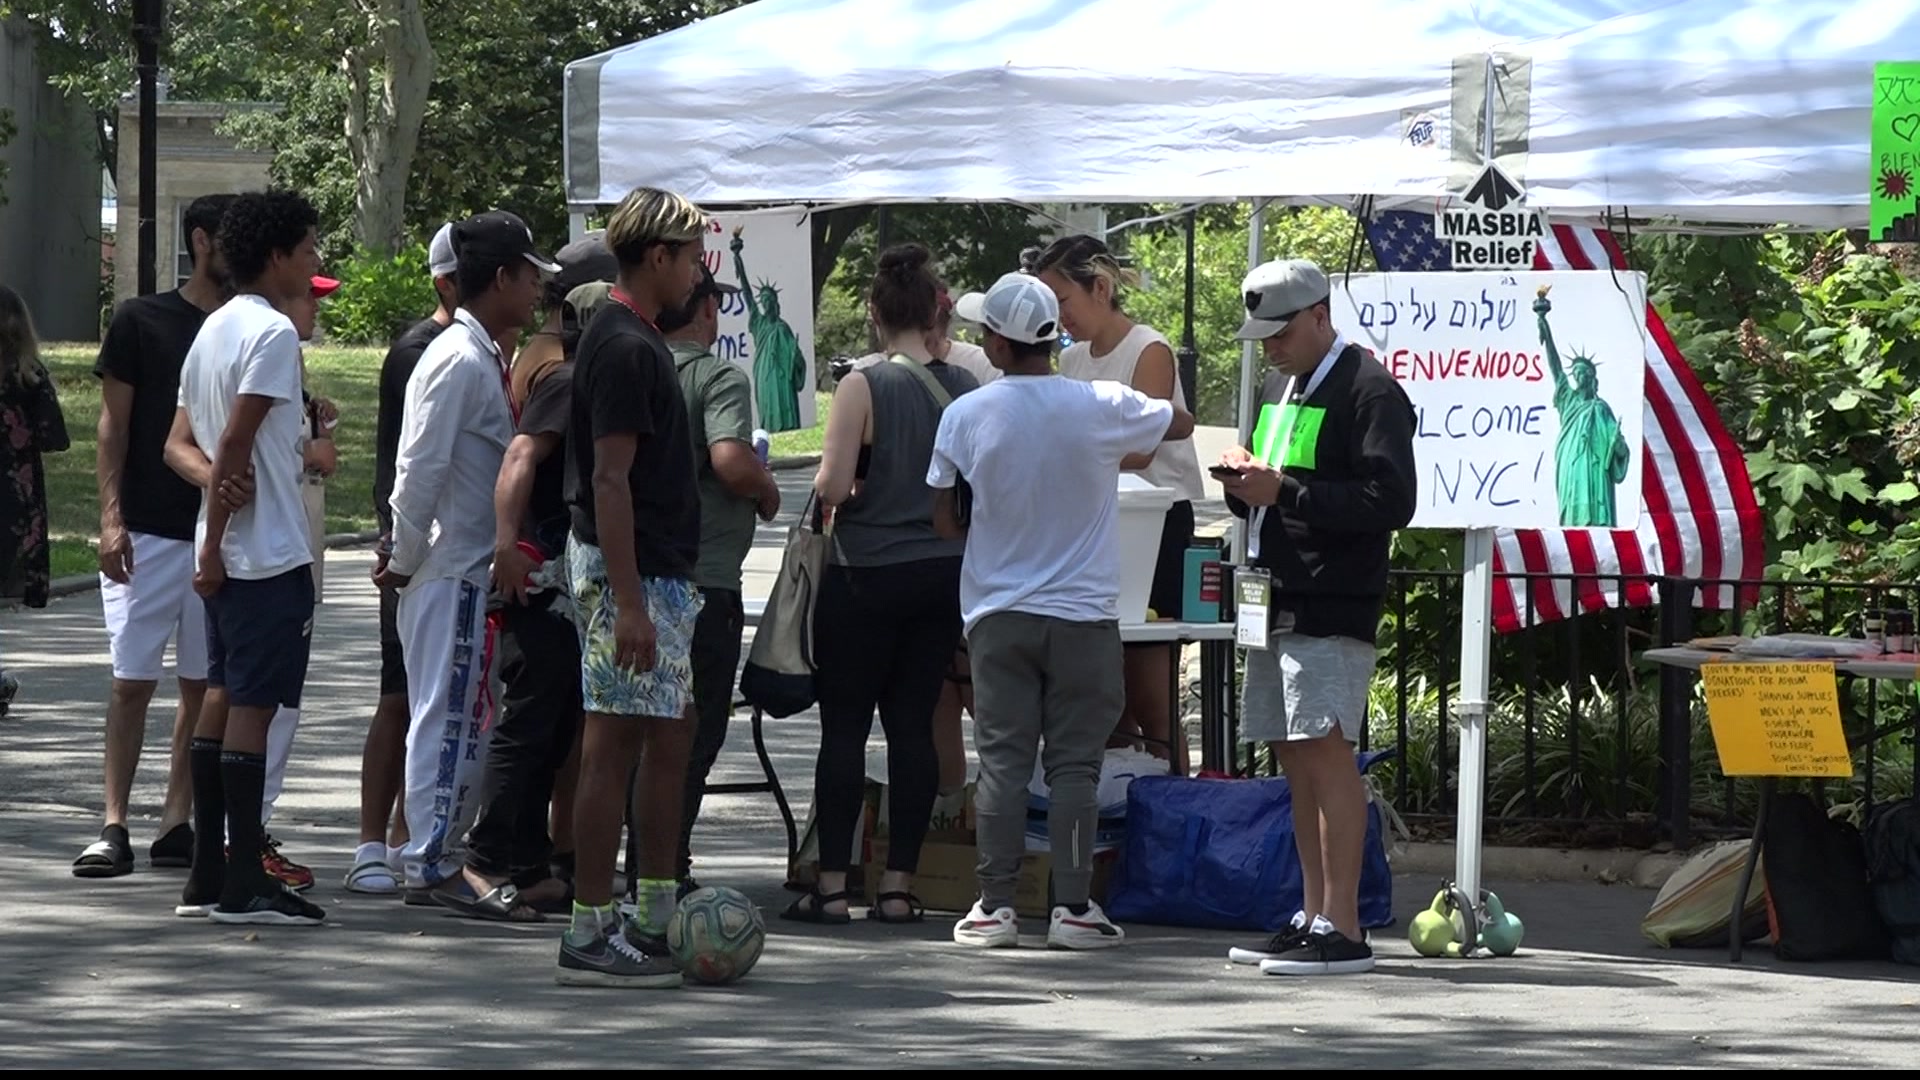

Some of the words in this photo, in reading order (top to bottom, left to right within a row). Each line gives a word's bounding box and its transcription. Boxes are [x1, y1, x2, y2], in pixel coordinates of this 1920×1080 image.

[1442, 212, 1543, 237] MASBIA
[1455, 240, 1532, 264] Relief
[1359, 287, 1436, 331] עליכם
[1449, 289, 1516, 331] שלום
[1368, 347, 1543, 382] IENVENIDOS
[1433, 451, 1544, 507] NYC!
[1758, 675, 1775, 685] FOR
[1775, 665, 1789, 674] AID
